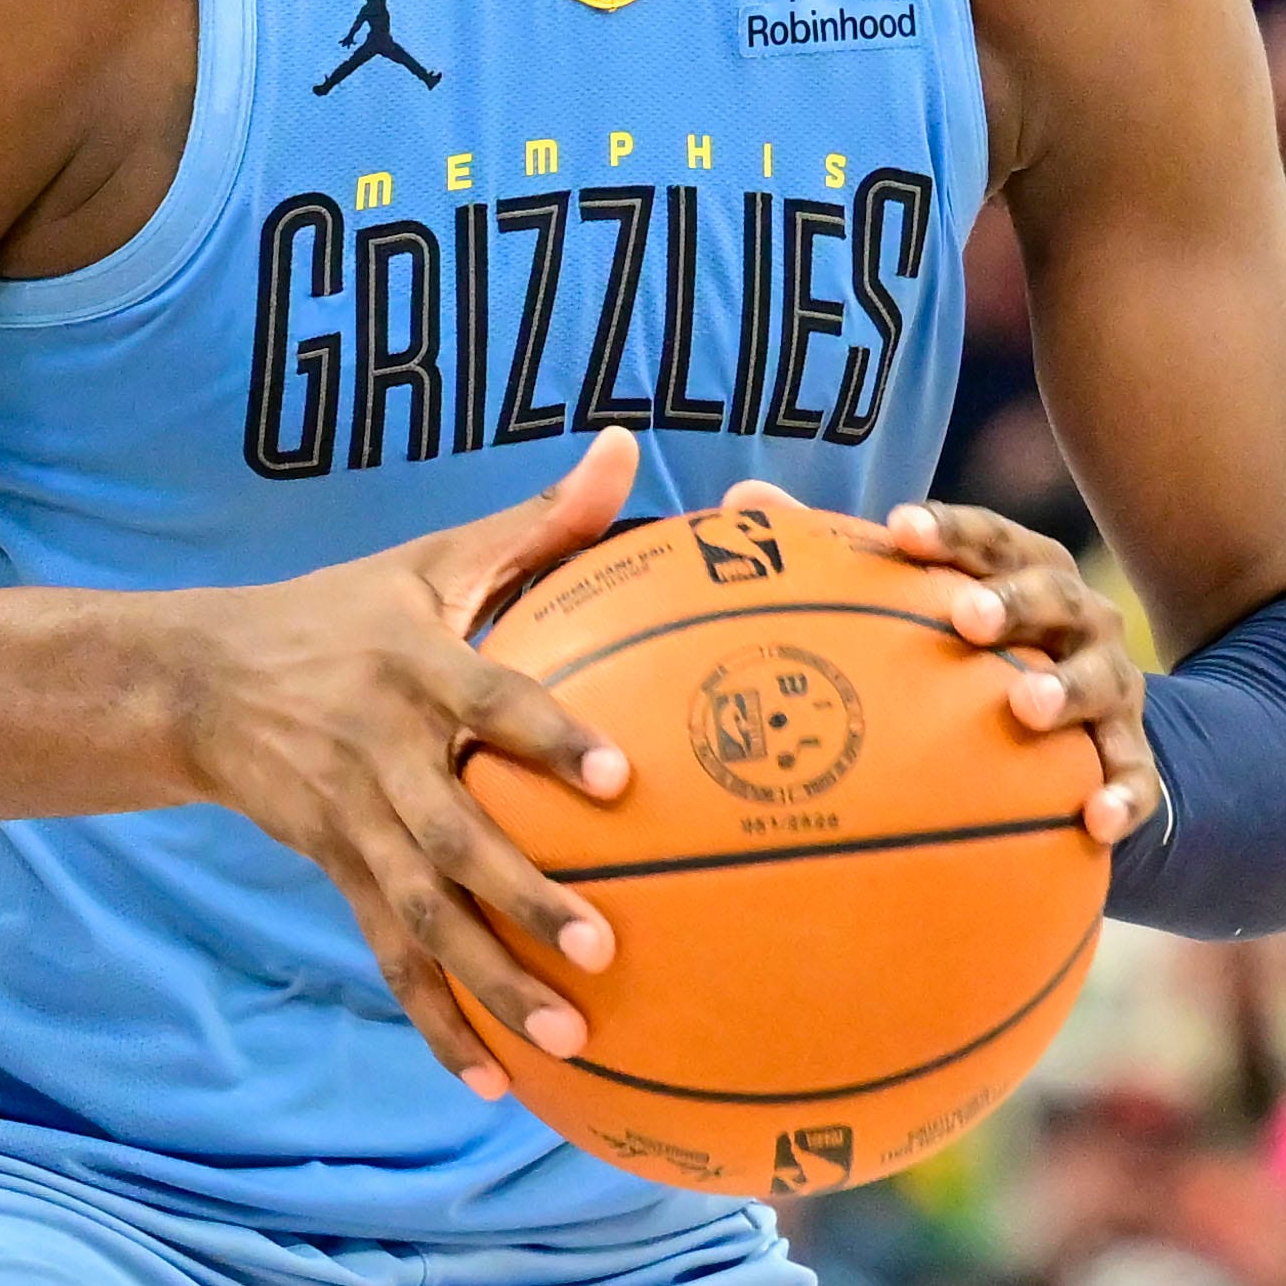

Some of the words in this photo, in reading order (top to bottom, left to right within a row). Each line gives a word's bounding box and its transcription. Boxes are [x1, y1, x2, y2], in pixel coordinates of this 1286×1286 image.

[747, 3, 917, 48] Robinhood
[354, 131, 848, 212] MEMPHIS
[244, 166, 933, 480] GRIZZLIES
